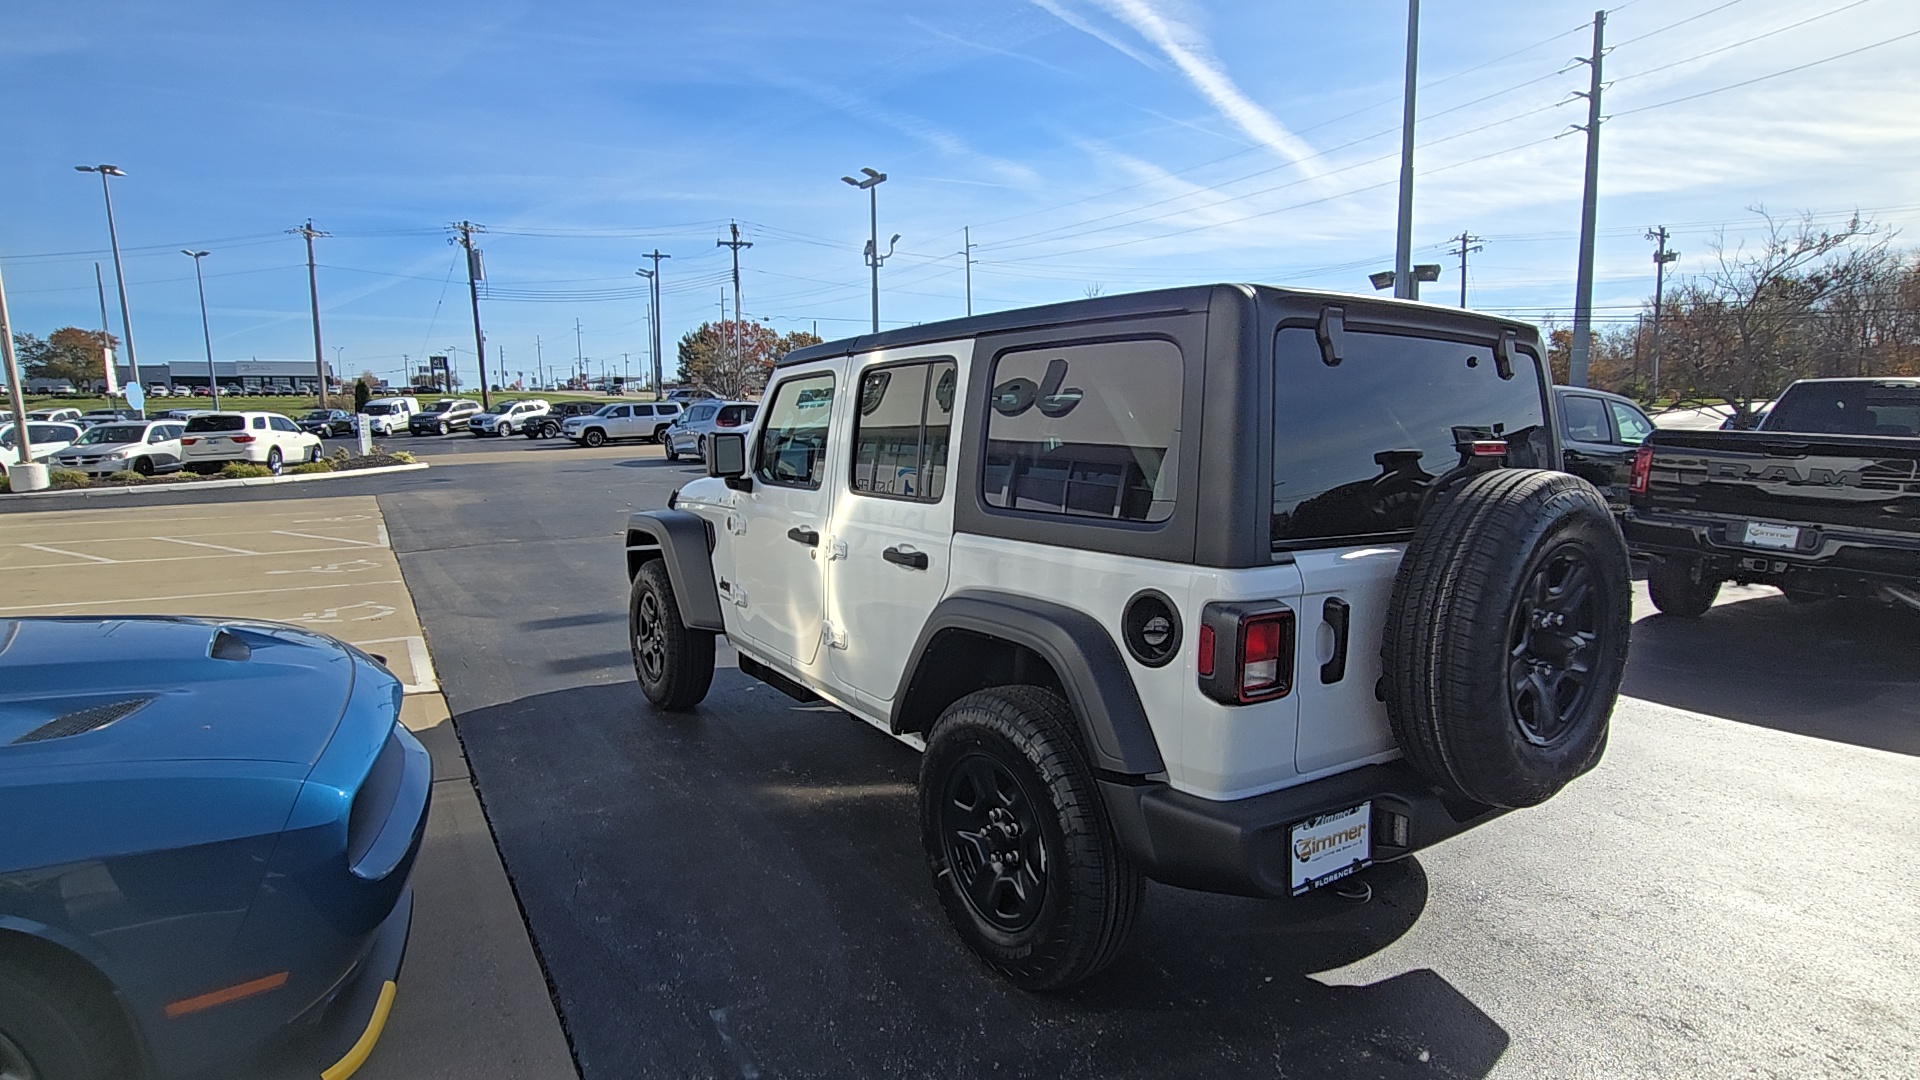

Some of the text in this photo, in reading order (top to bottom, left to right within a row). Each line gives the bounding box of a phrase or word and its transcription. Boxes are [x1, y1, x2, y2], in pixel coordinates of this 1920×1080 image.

[1707, 462, 1864, 486] RAM
[1313, 807, 1354, 828] Zimmer
[1298, 823, 1367, 859] Zimmer
[1315, 866, 1354, 889] FLORENCE
